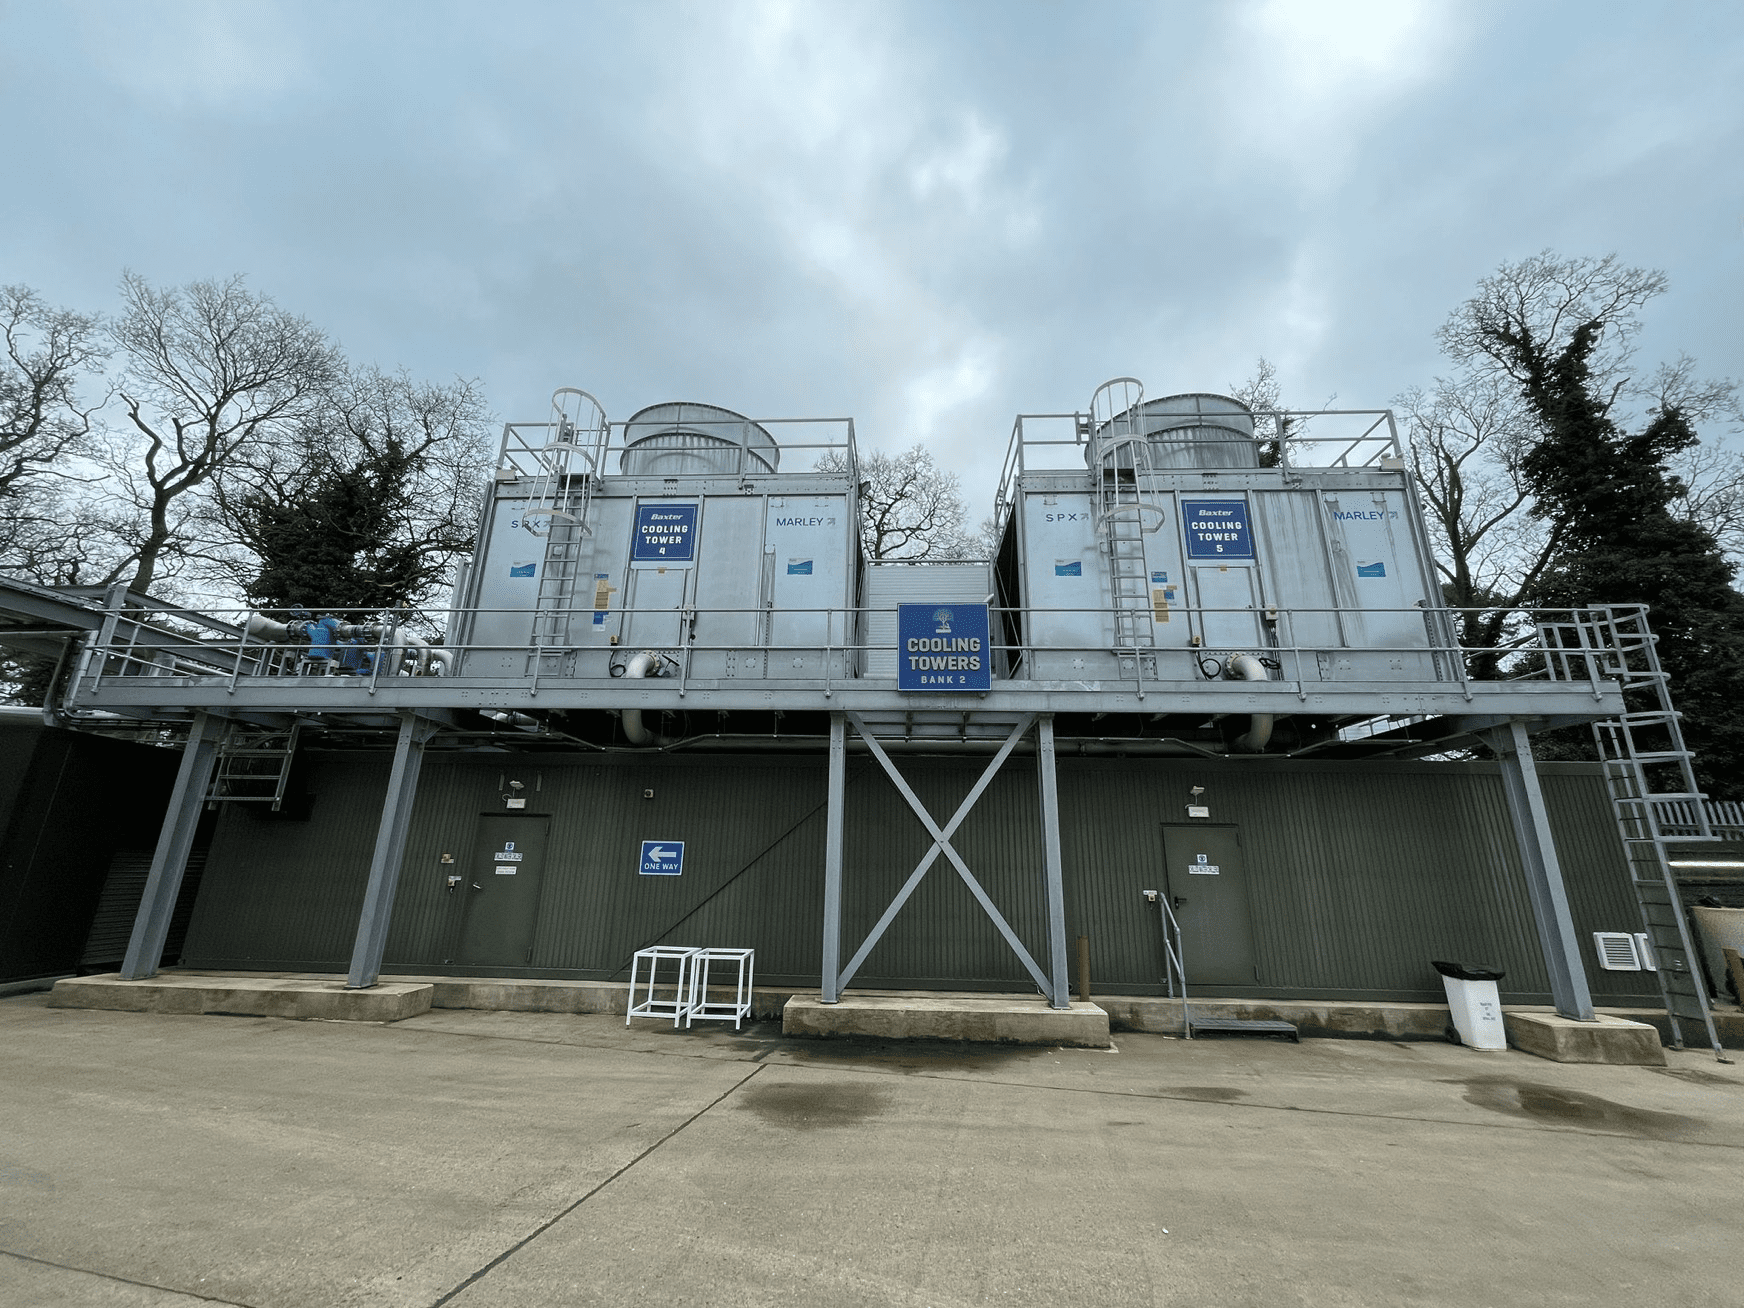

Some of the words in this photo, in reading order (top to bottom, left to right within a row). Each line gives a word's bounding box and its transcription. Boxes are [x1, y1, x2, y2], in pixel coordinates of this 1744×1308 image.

[1046, 513, 1077, 522] SPX
[1333, 511, 1384, 520] MARLEY
[776, 517, 824, 526] MARLEY
[1191, 521, 1242, 530] COOLING
[641, 525, 688, 533] COOLING
[645, 536, 682, 544] TOWER
[1198, 533, 1238, 541] TOWER
[659, 547, 666, 555] 4
[1216, 544, 1224, 552] 5
[907, 638, 981, 652] COOLING
[908, 656, 981, 671] TOWERS
[921, 676, 953, 684] BANK
[960, 676, 966, 684] 2
[644, 862, 661, 870] ONE
